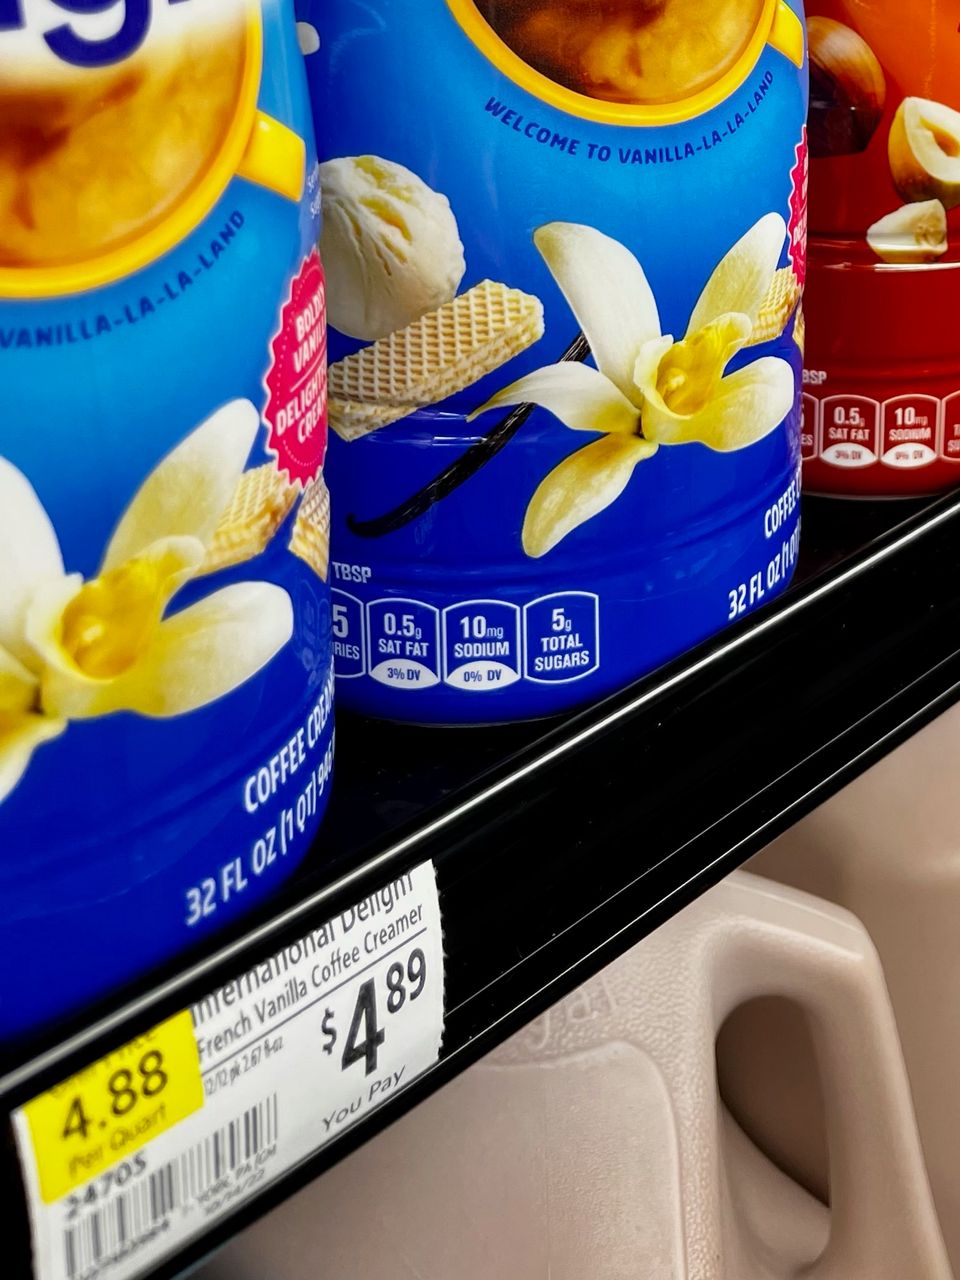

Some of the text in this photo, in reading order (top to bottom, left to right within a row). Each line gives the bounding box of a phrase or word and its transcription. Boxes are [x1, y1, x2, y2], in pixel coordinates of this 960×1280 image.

[485, 70, 775, 164] WELCOME TO VANILLA-LA-LA-LAND
[802, 369, 828, 385] BSP
[833, 406, 865, 428] 0.5g
[894, 407, 928, 426] 10mg
[828, 427, 848, 440] SAT
[850, 428, 870, 442] FAT
[889, 426, 932, 442] SODIUM
[764, 479, 797, 540] COFFEE
[332, 561, 372, 583] TBSP
[728, 583, 747, 620] 32
[749, 571, 765, 606] FL
[767, 553, 781, 590] OZ
[383, 607, 572, 639] 0.5g 10mg 5g
[332, 641, 360, 660] RIES
[378, 638, 510, 658] SAT FAT SODIUM
[541, 632, 584, 653] TOTAL
[387, 666, 421, 681] 3% DV
[534, 650, 590, 671] SUGARS
[463, 668, 502, 683] 0% DV
[244, 726, 307, 813] COFFEE
[186, 877, 217, 927] 32
[221, 856, 248, 903] FL
[252, 825, 277, 877] OZ
[196, 1009, 252, 1062] French
[254, 978, 308, 1025] Vanilla
[311, 945, 361, 988] Coffee
[363, 903, 424, 954] Creamer
[62, 1048, 168, 1141] 4.88
[321, 1065, 407, 1132] You Pay
[69, 1103, 168, 1178] Per Quart
